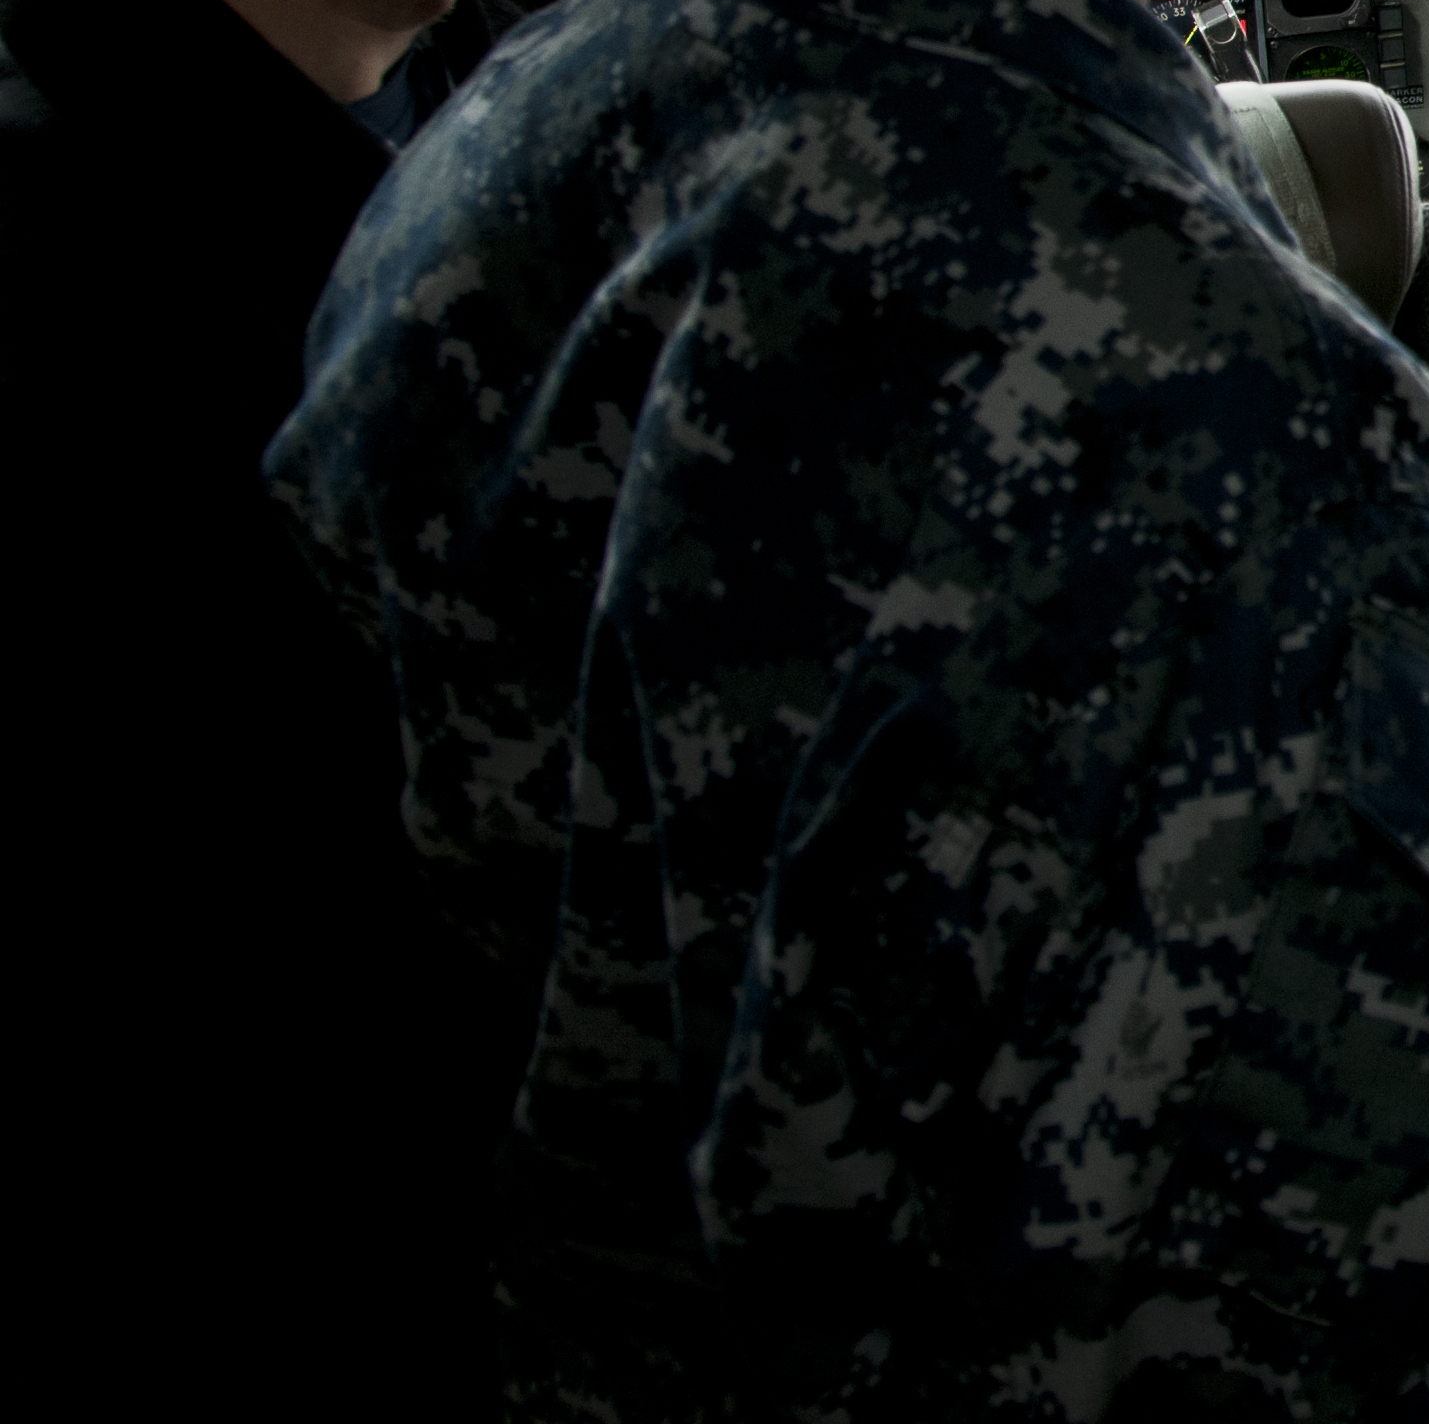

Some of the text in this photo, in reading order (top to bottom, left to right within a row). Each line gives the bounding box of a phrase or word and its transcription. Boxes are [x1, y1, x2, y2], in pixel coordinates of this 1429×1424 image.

[1173, 6, 1186, 17] 33
[1391, 87, 1424, 96] ARKER
[1399, 95, 1423, 104] ACON
